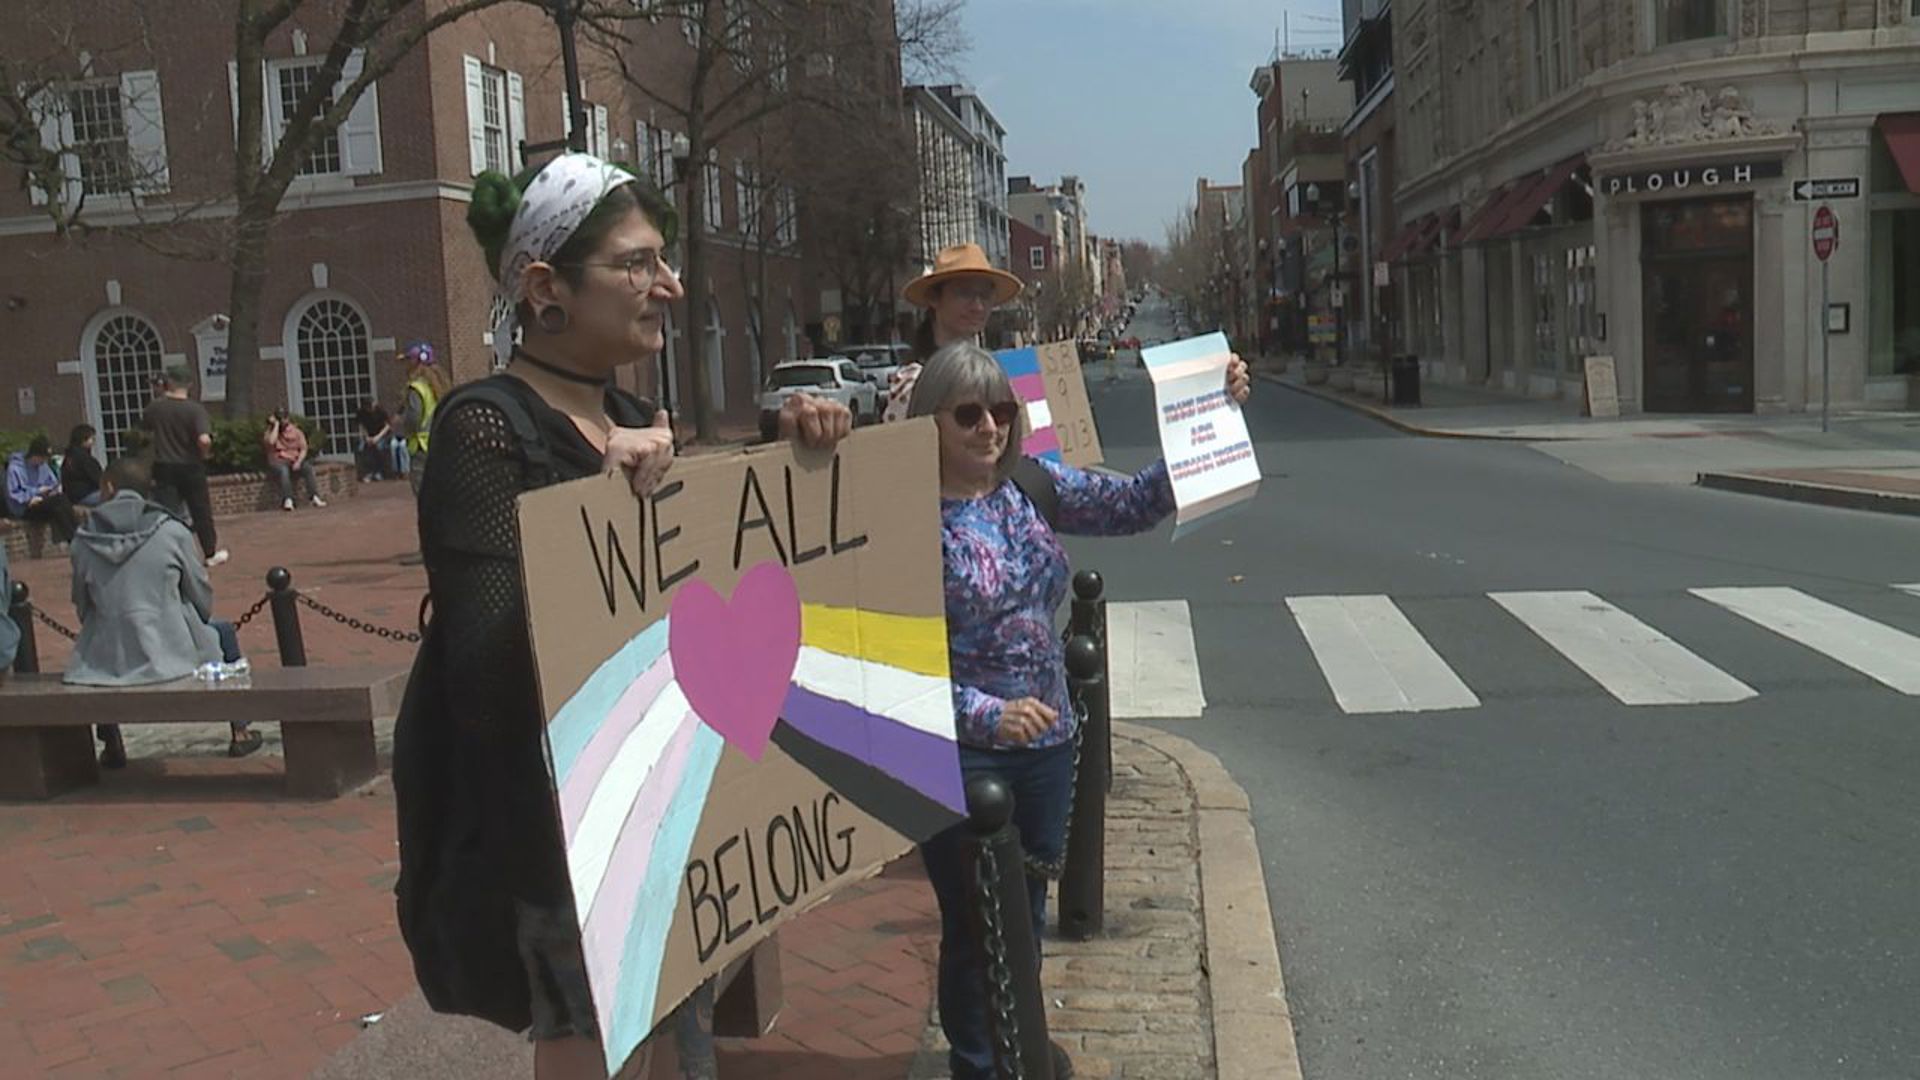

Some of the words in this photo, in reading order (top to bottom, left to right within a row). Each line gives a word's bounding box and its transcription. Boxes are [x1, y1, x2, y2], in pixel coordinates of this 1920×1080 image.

[1610, 165, 1751, 196] PLOUGH
[581, 480, 700, 616] WE
[733, 454, 868, 570] ALL
[687, 792, 856, 963] BELONG
